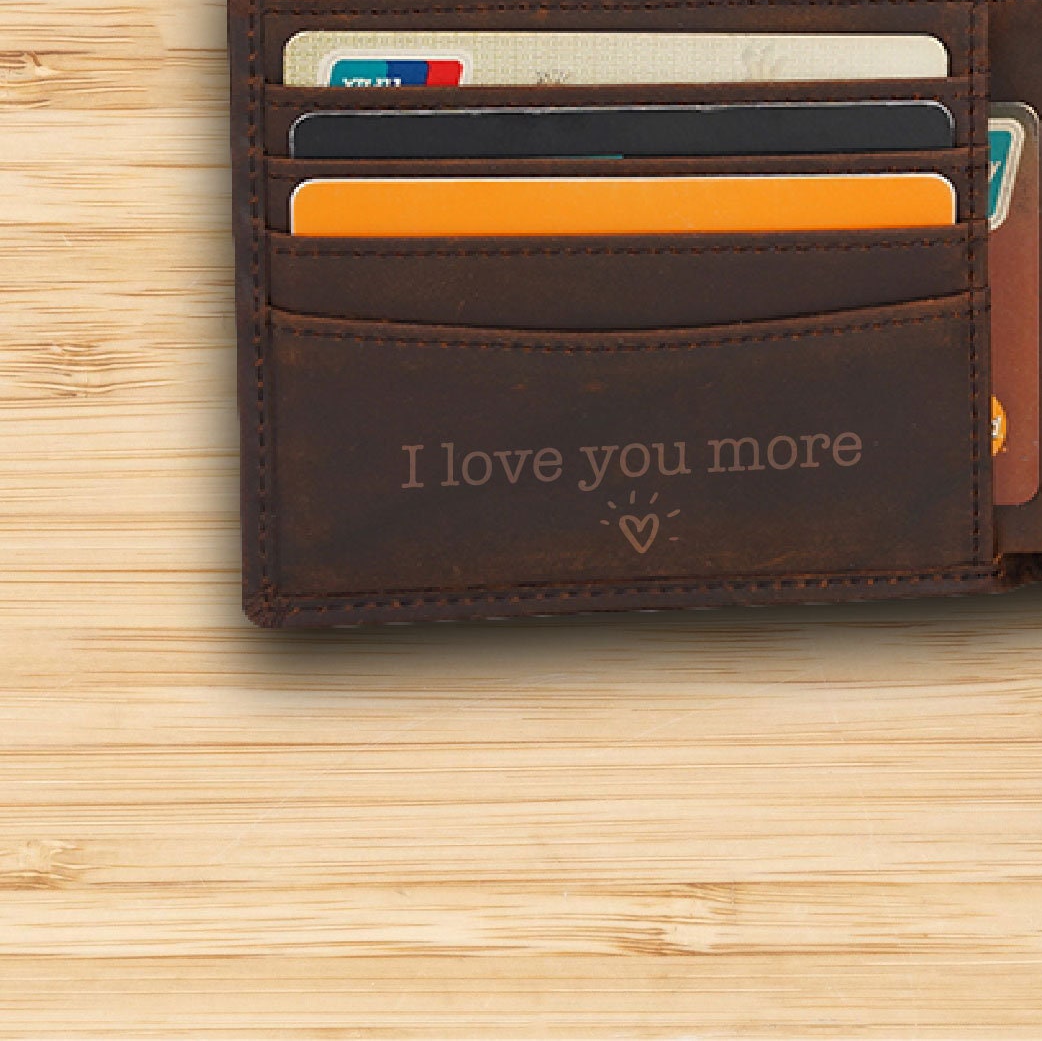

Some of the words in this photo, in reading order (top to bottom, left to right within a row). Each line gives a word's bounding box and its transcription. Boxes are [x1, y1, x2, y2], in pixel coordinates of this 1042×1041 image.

[401, 444, 424, 489] I
[440, 442, 563, 487] love
[577, 439, 692, 492] you
[706, 430, 863, 474] more
